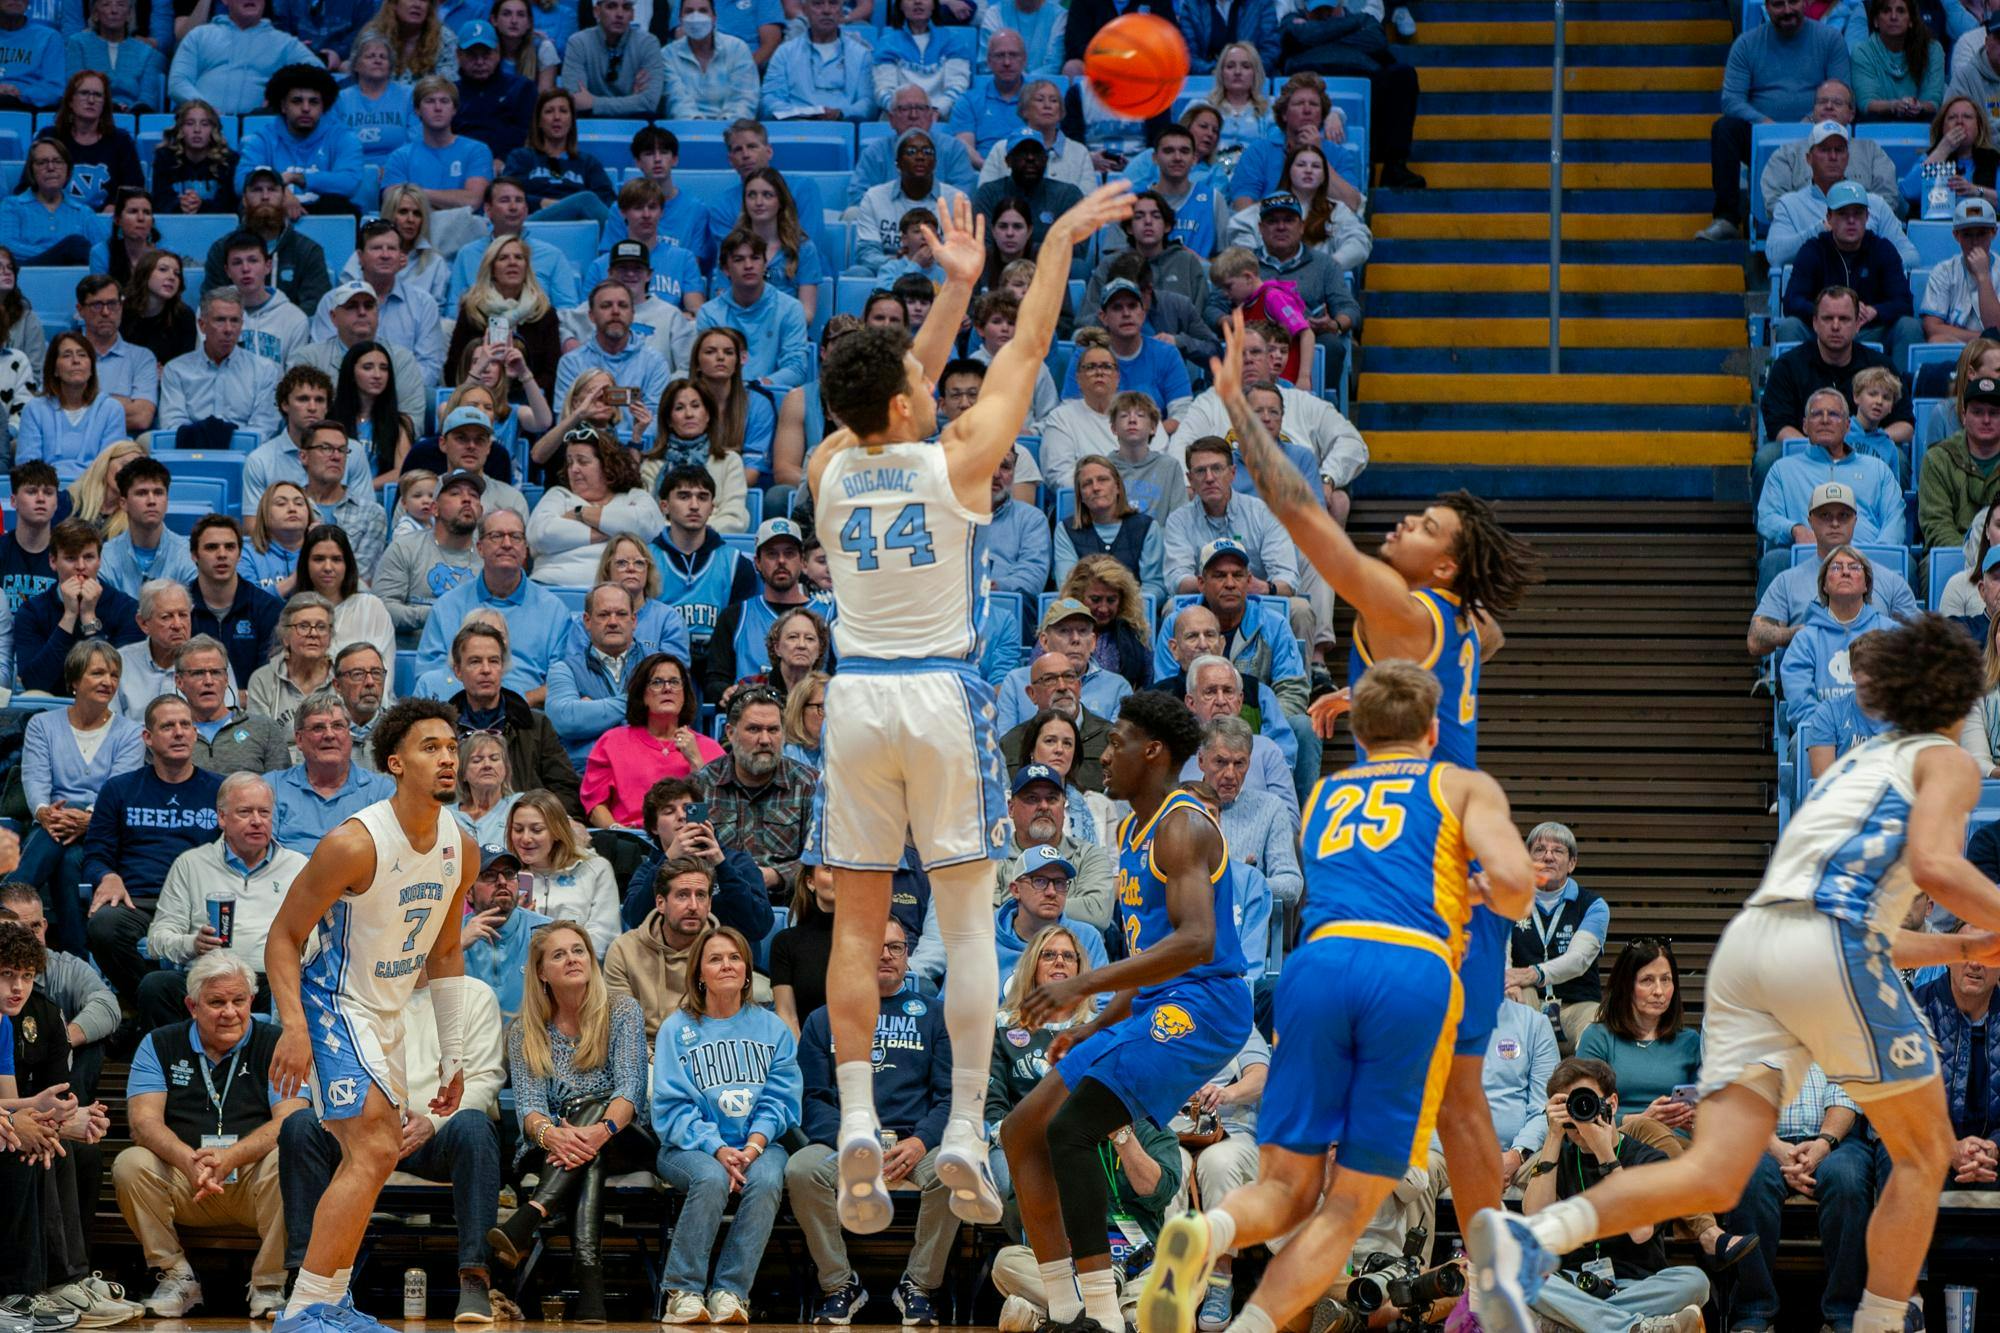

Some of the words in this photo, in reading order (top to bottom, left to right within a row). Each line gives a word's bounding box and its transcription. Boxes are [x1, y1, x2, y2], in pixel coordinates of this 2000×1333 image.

[842, 468, 918, 499] BOGAVAC
[840, 502, 937, 572] 44
[126, 806, 195, 829] HEELS
[1317, 778, 1415, 860] 25
[398, 881, 444, 907] NORTH
[402, 907, 432, 952] 7
[679, 1039, 775, 1092] AROLIN
